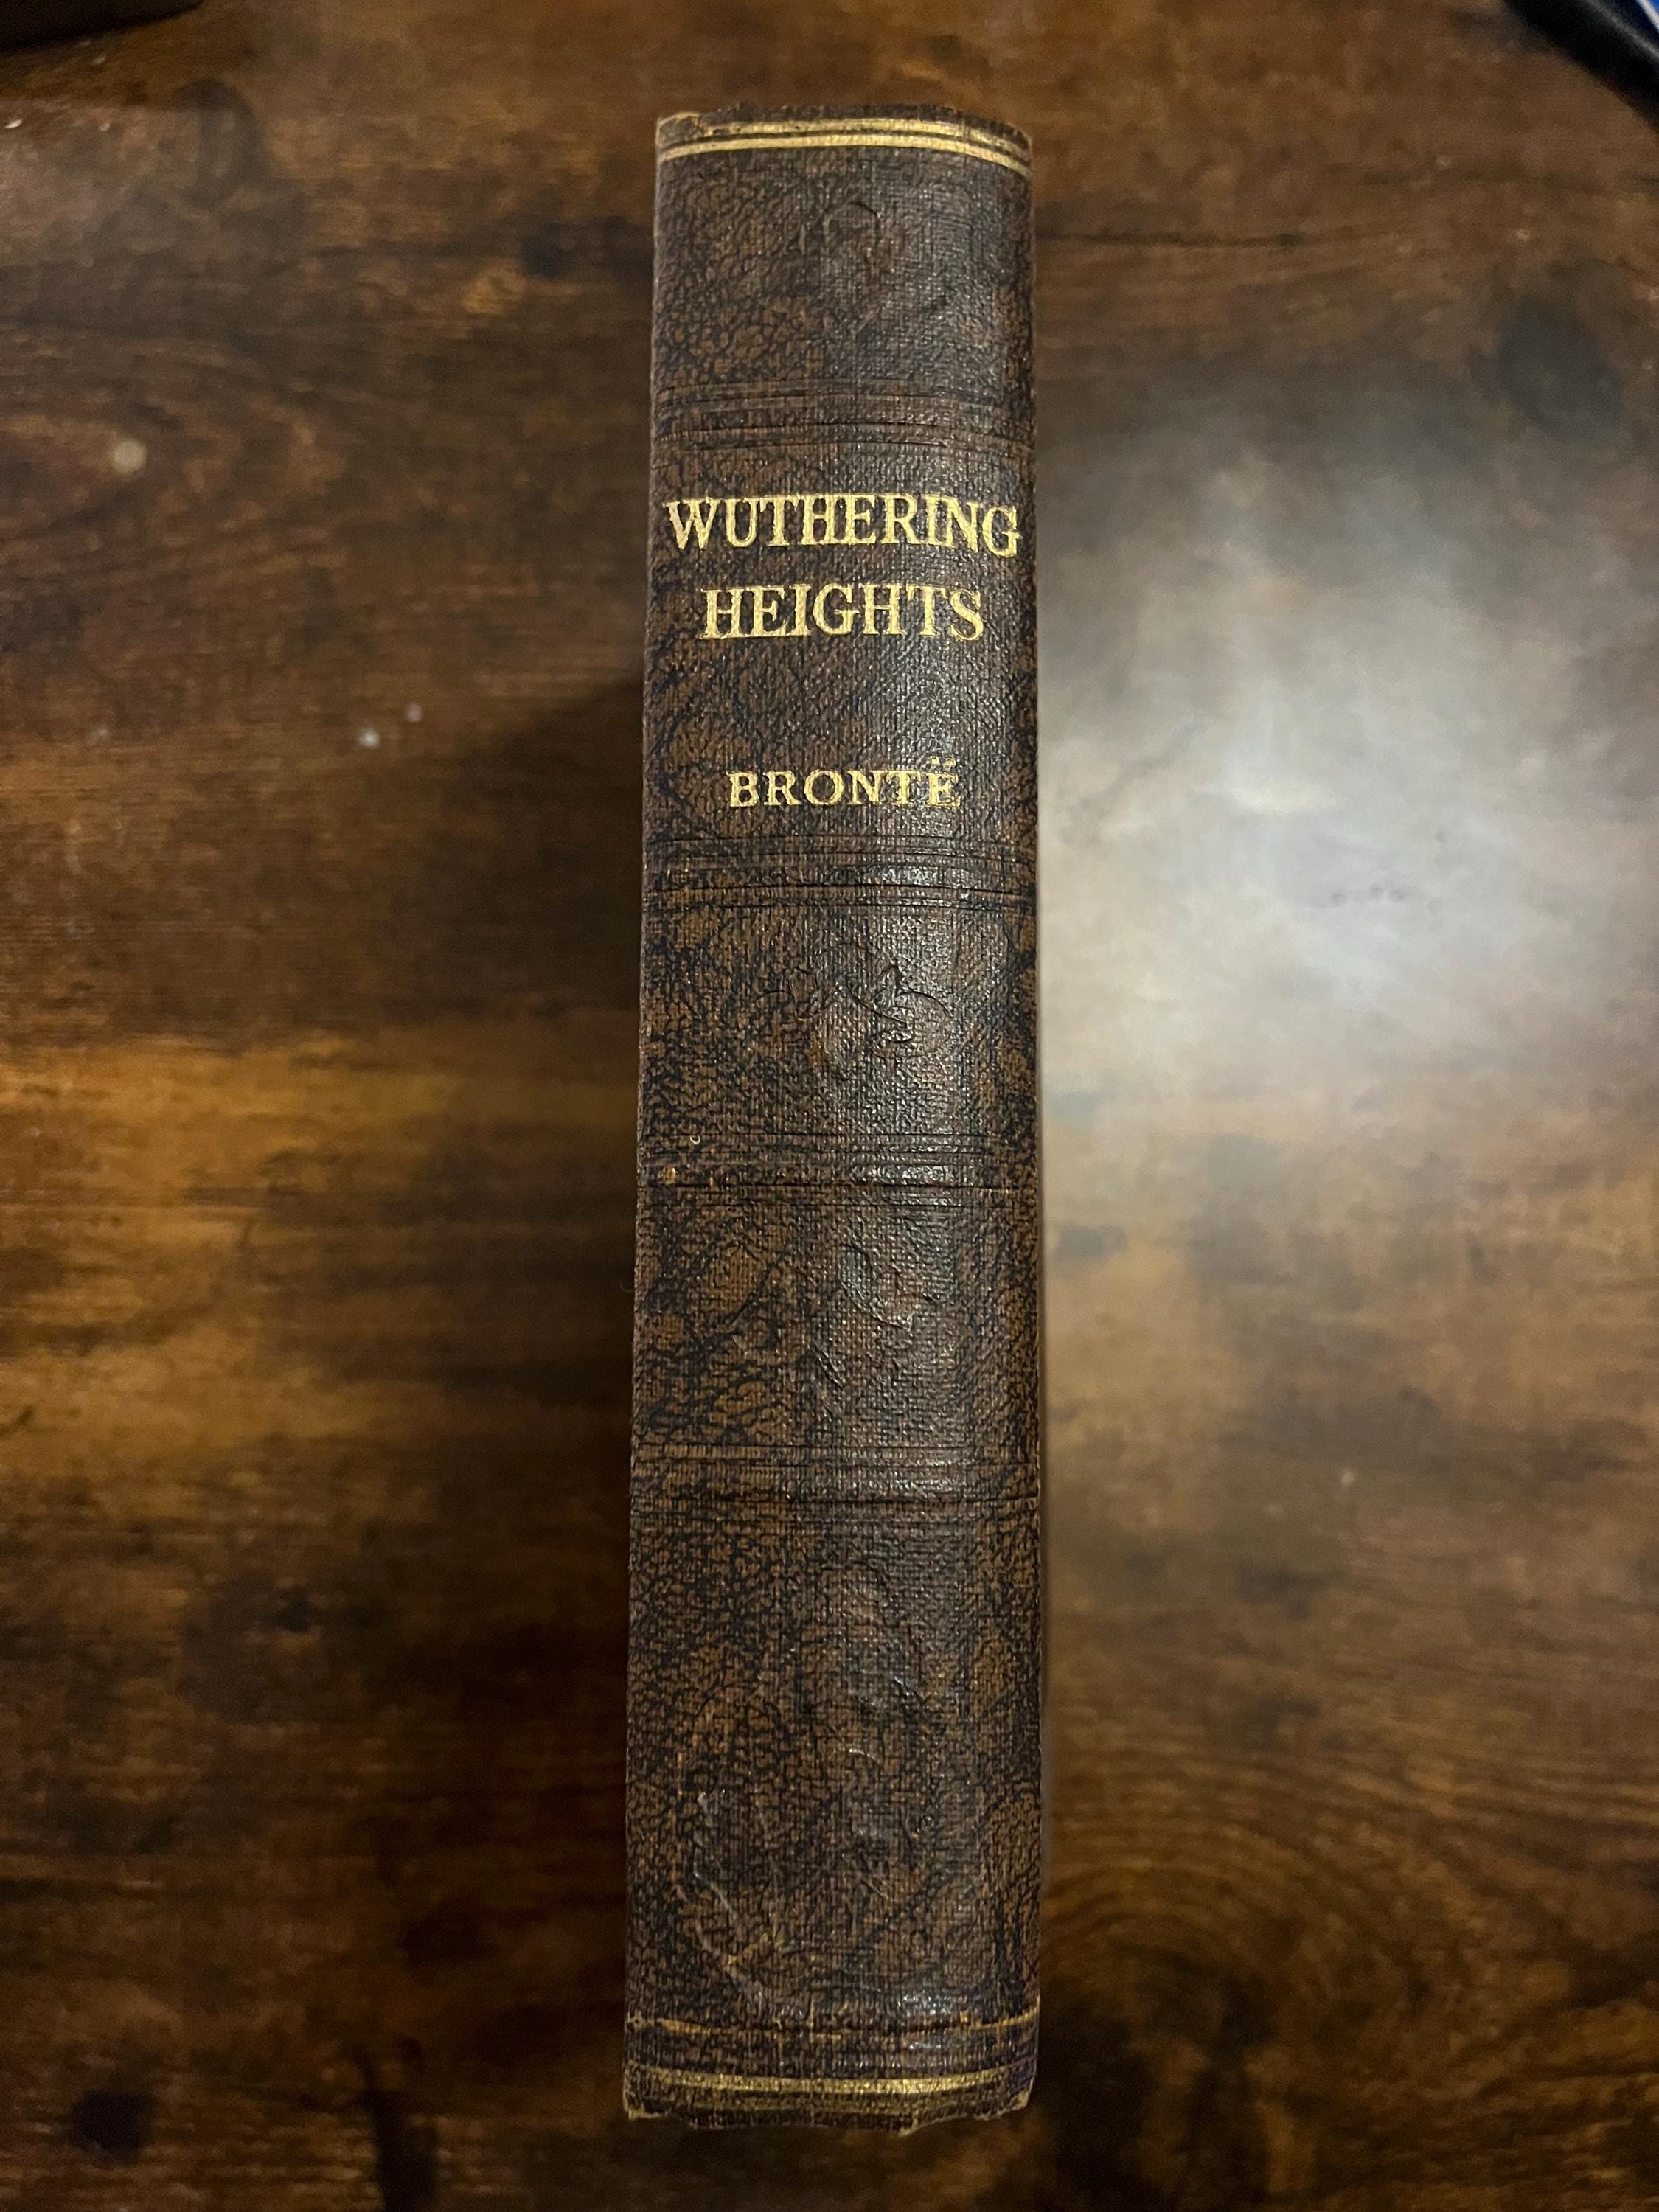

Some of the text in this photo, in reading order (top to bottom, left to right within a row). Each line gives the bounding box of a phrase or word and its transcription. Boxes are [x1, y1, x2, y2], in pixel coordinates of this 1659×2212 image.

[664, 492, 1021, 557] WUTHERING
[699, 583, 984, 641] HEIGHTS
[726, 757, 961, 808] BRONTË
